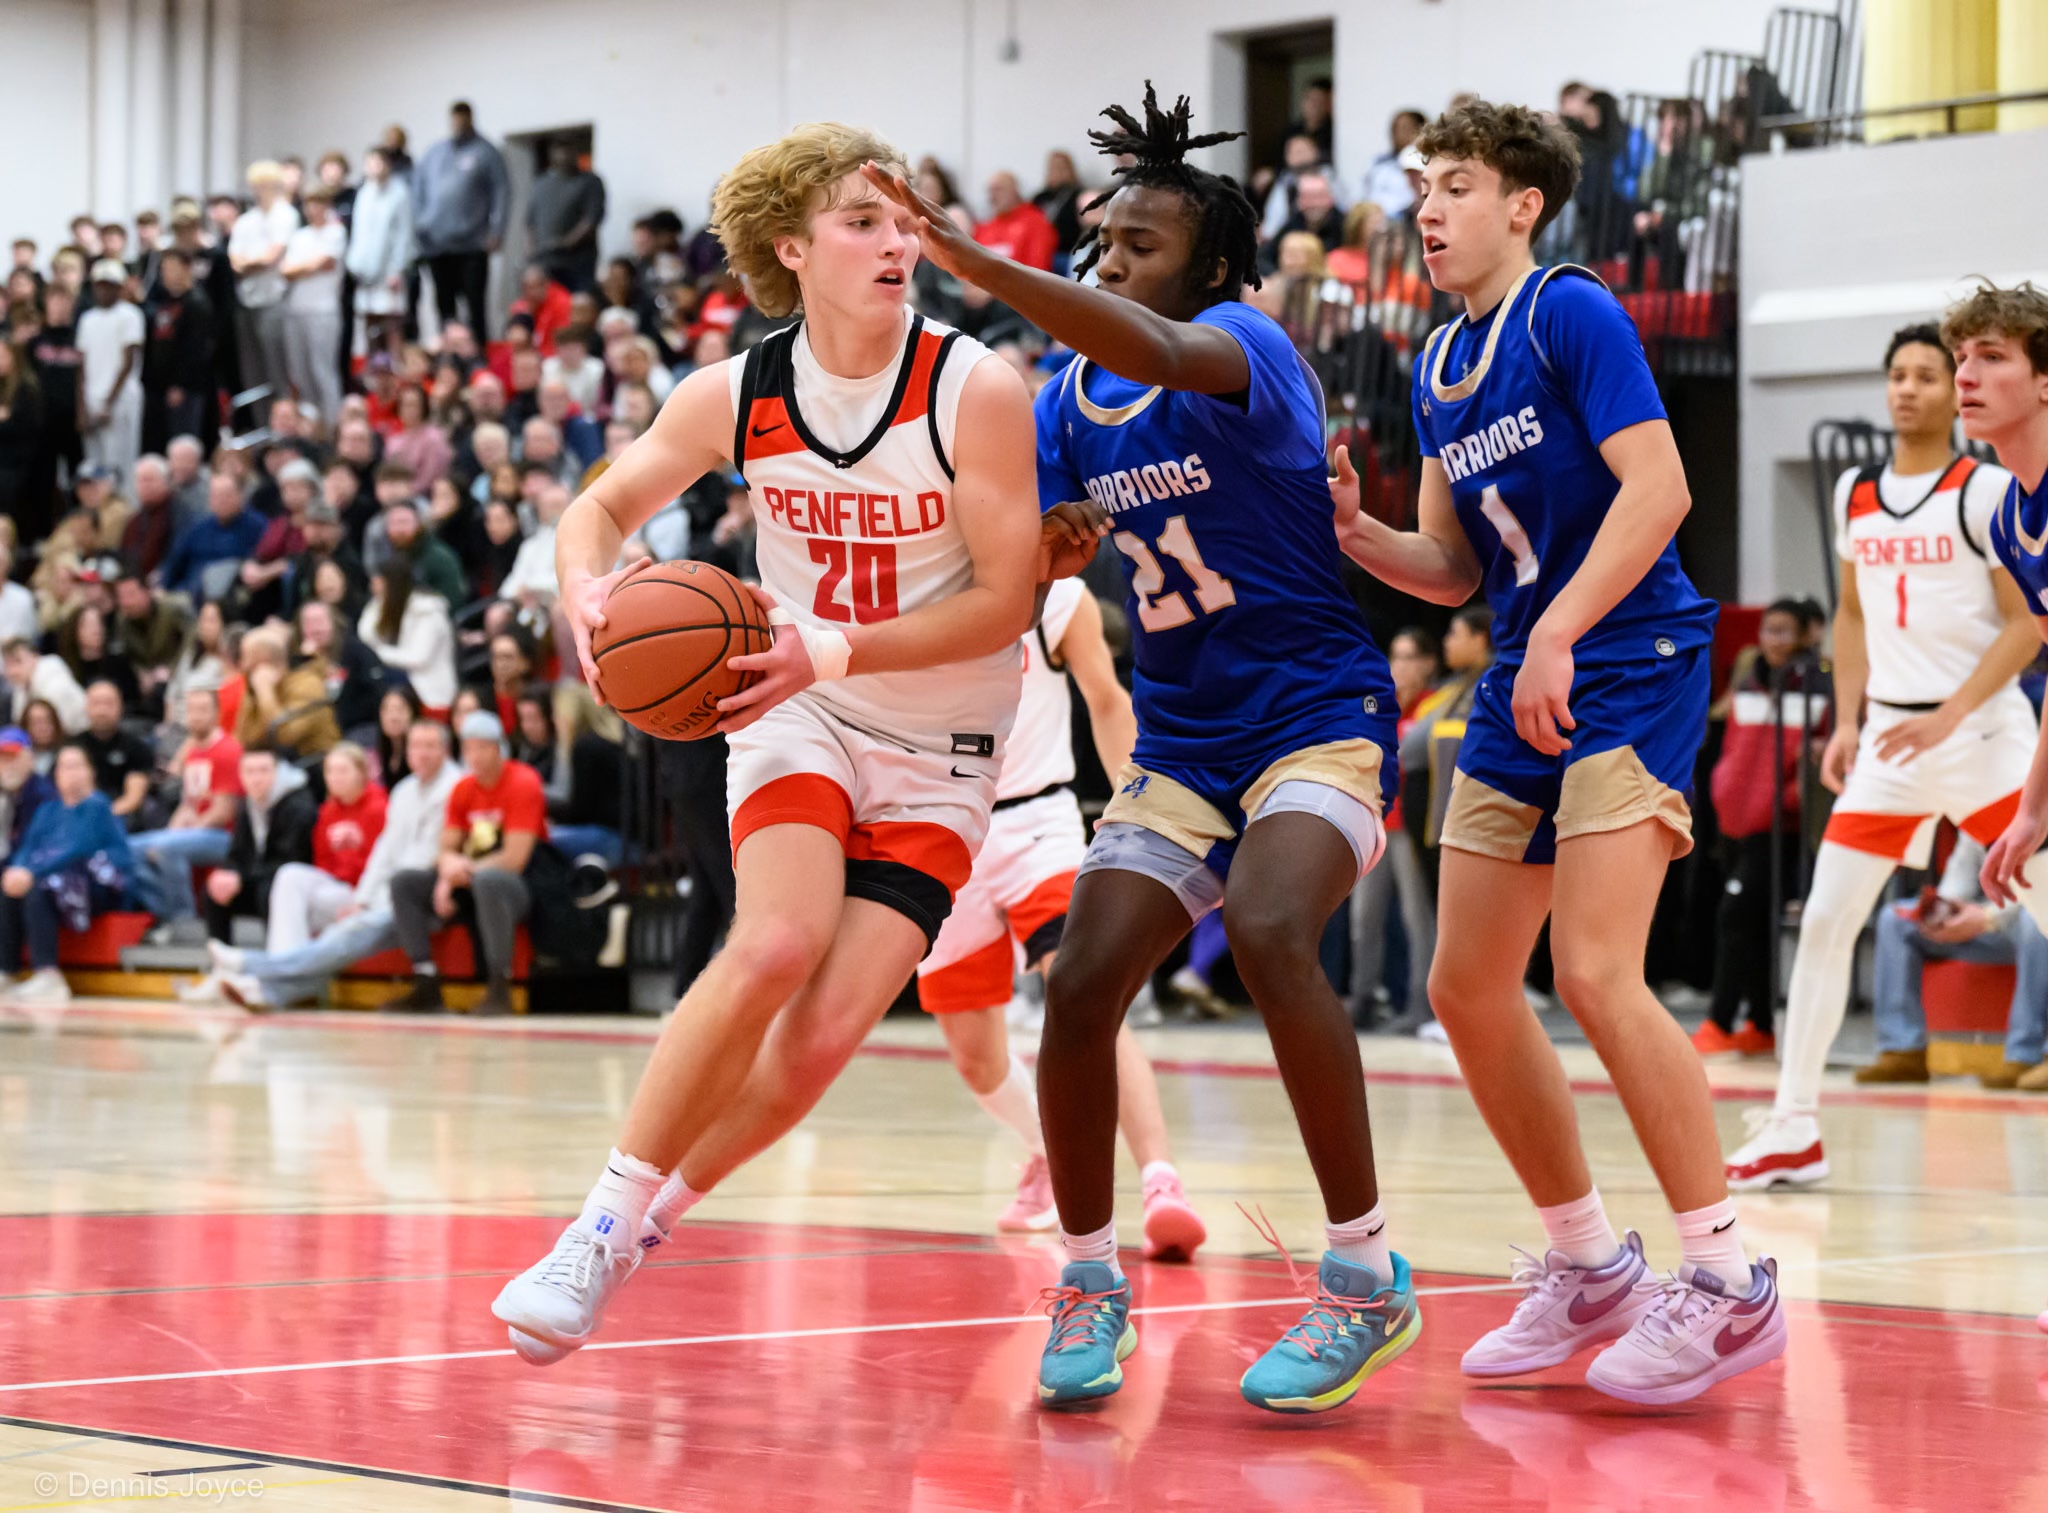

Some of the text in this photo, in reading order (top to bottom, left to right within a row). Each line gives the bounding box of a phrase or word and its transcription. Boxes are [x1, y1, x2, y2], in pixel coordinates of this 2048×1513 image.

[1439, 405, 1544, 485] ARRIORS
[763, 486, 945, 538] PENFIELD
[1479, 483, 1540, 588] 1
[1854, 535, 1953, 566] PENFIELD
[806, 537, 899, 626] 20
[1113, 514, 1237, 633] 21
[1895, 573, 1908, 631] 1
